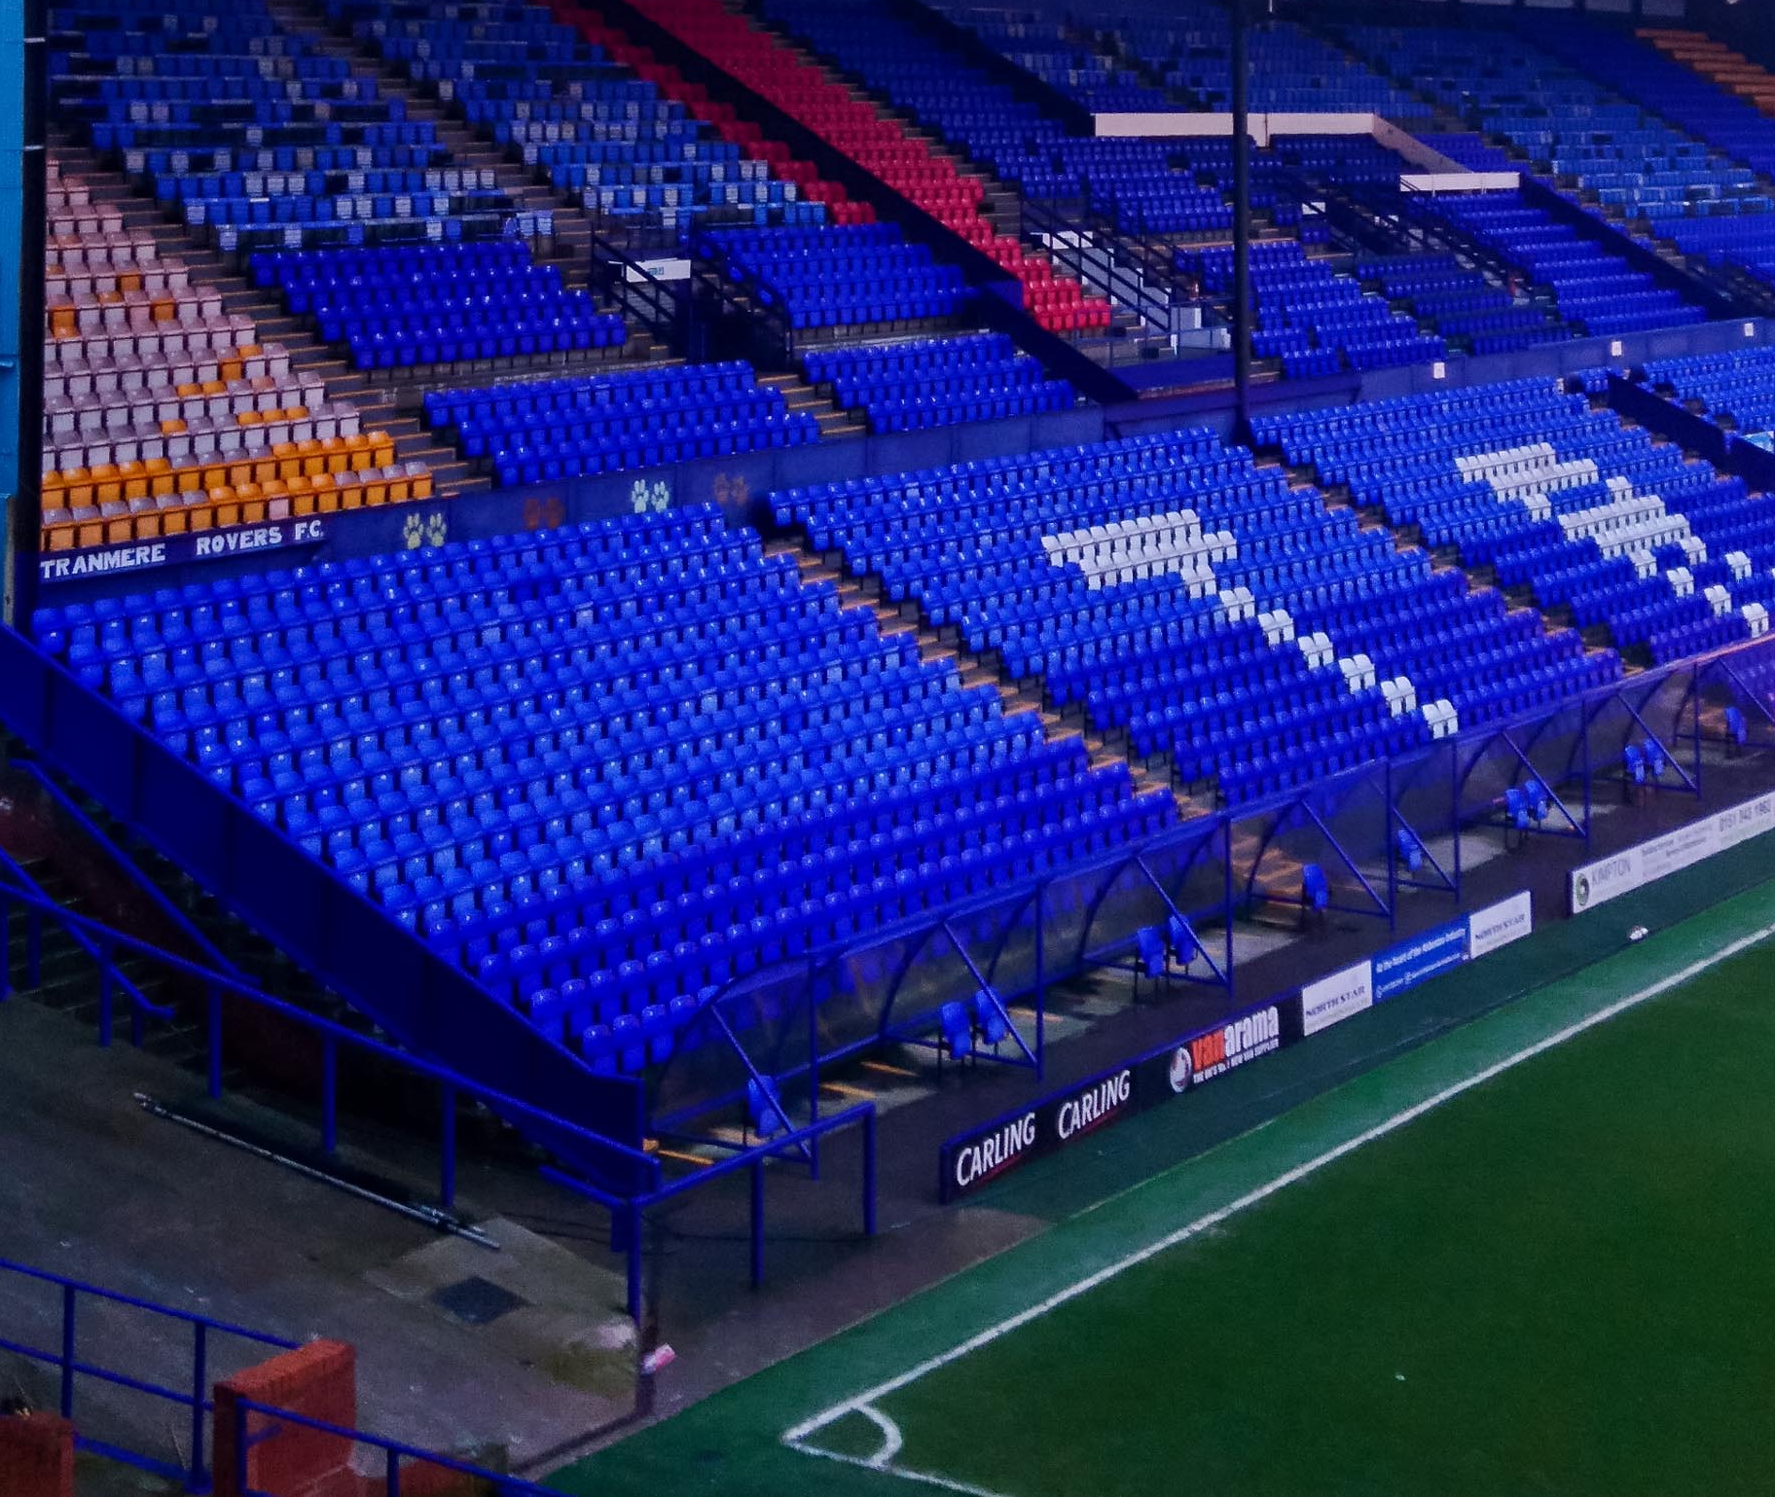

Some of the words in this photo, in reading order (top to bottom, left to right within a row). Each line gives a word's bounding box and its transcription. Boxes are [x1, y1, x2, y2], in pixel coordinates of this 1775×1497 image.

[40, 543, 166, 579] TRANMERE
[196, 526, 283, 555] ROVERS
[295, 520, 324, 541] F.C.
[1192, 1005, 1280, 1071] vanarama
[956, 1112, 1036, 1187] CARLING
[1058, 1069, 1130, 1139] CARLING
